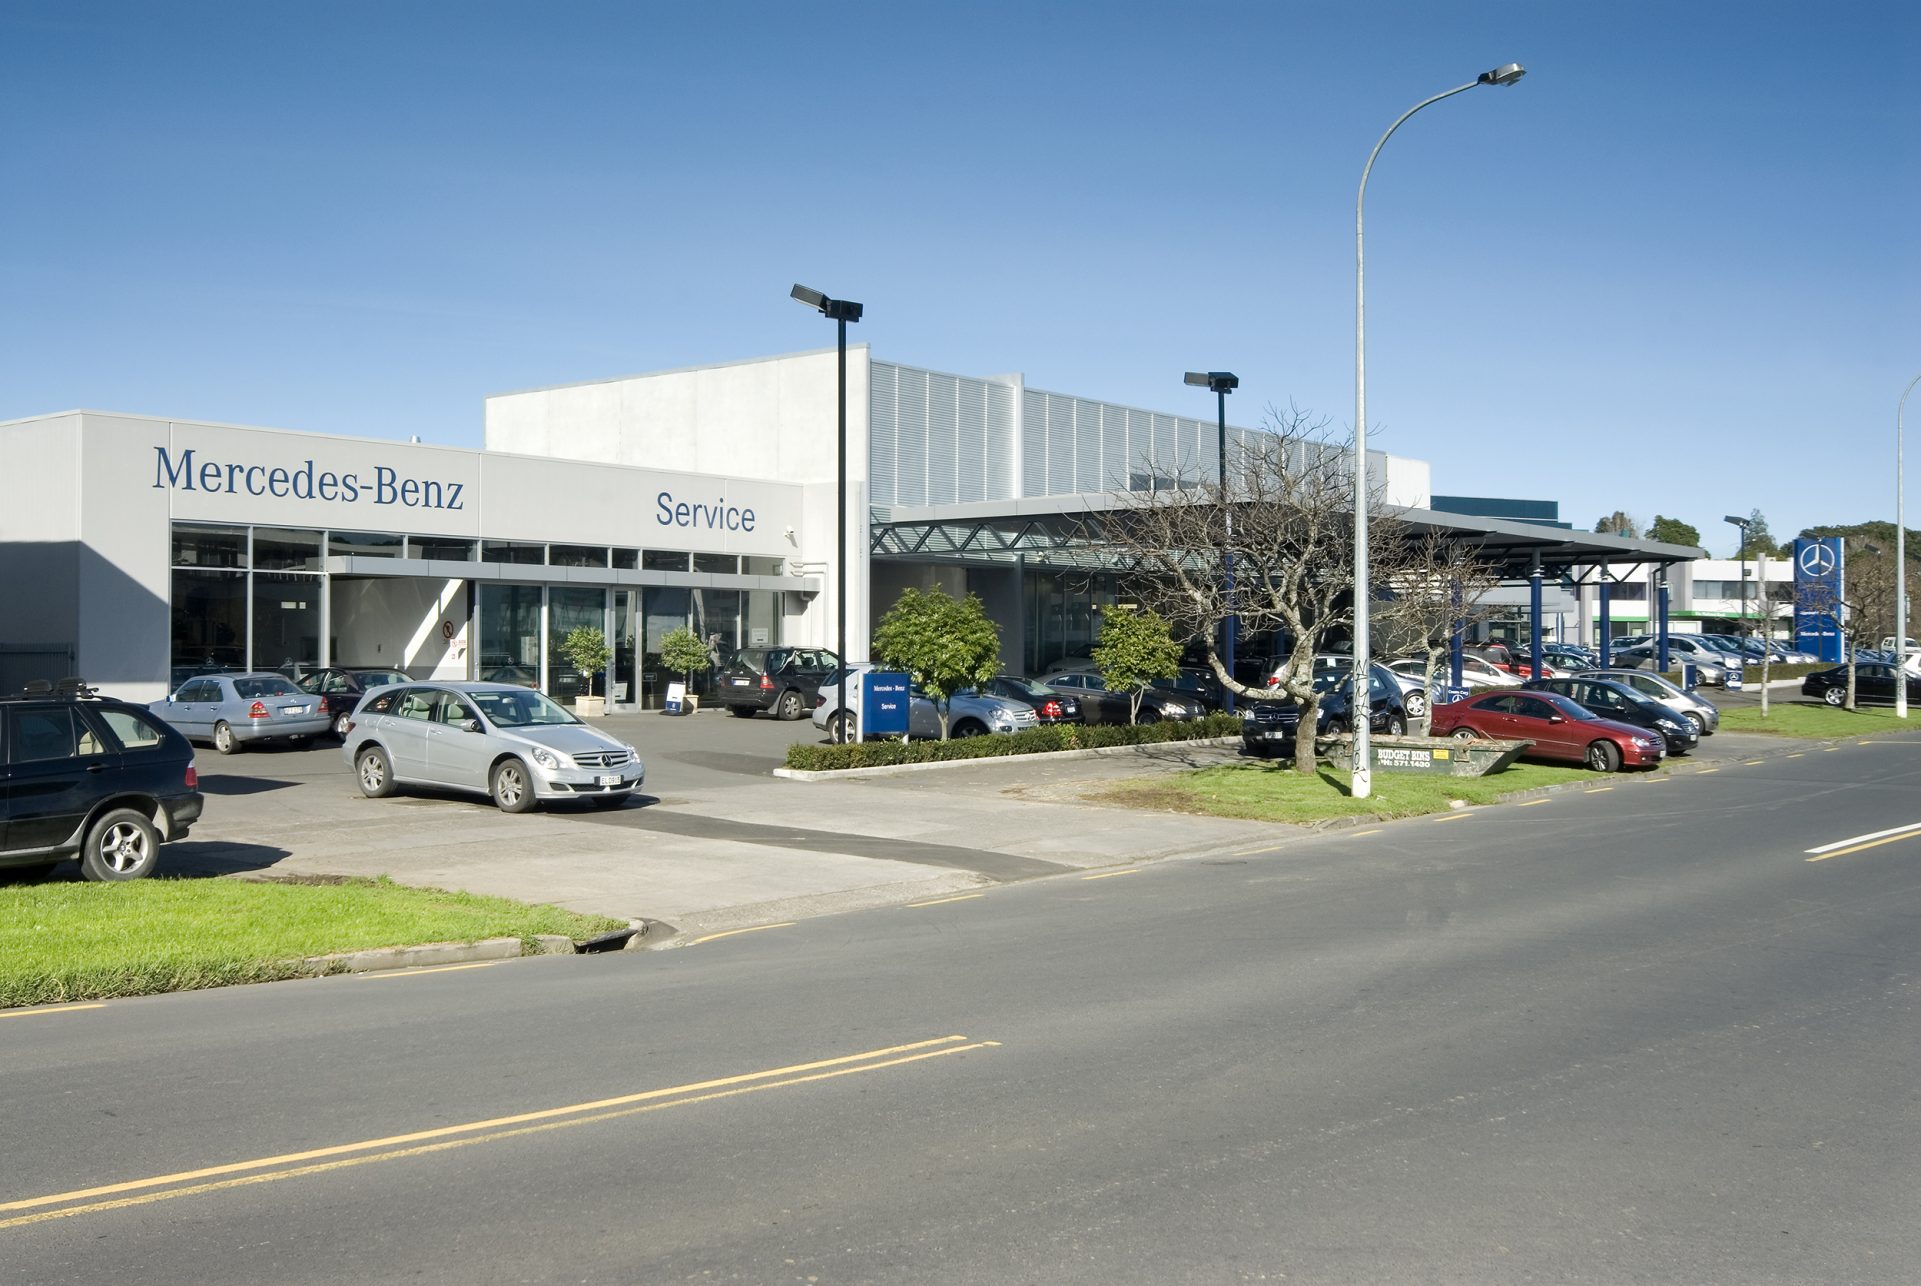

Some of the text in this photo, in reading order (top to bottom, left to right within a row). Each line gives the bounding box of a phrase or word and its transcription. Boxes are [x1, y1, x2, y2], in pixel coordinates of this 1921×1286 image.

[152, 446, 465, 511] Mercedes-Benz
[656, 492, 755, 532] Service
[881, 702, 897, 710] Service
[1377, 749, 1410, 760] BUDGET
[1411, 750, 1430, 761] BINS
